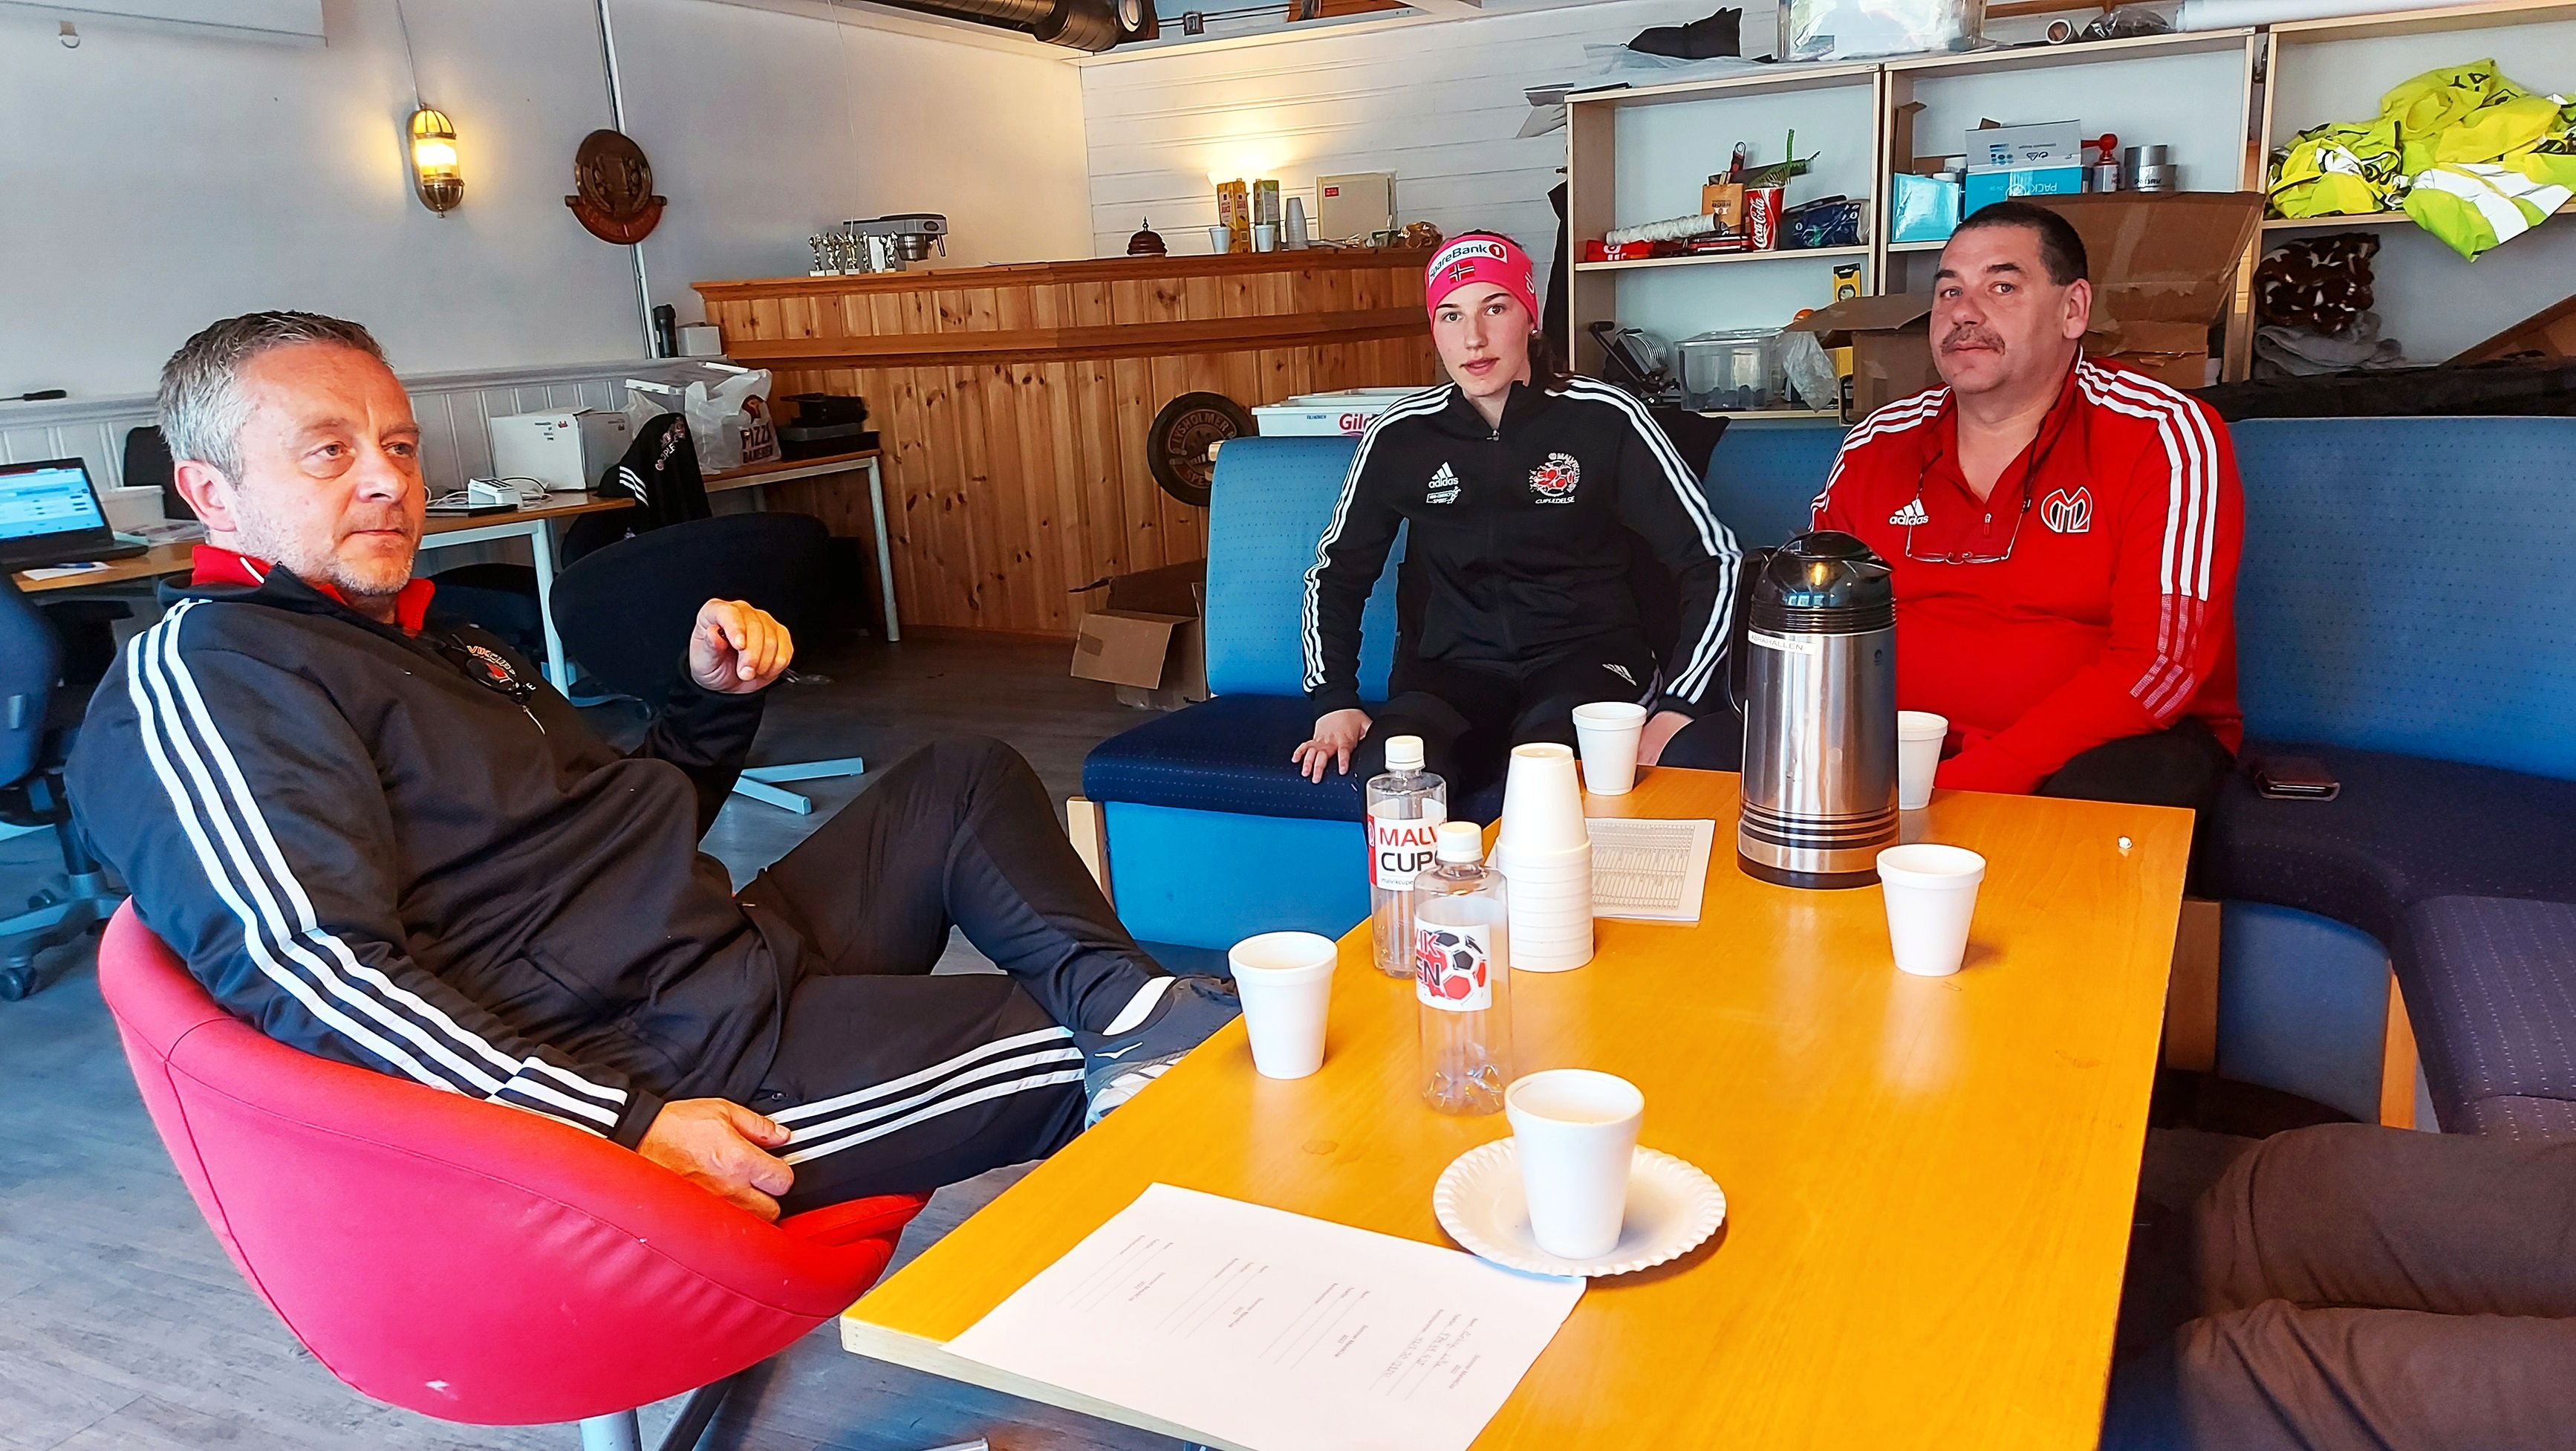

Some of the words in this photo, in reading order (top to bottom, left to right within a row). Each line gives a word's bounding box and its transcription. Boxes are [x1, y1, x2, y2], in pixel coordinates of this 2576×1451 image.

[1428, 477, 1460, 489] adidas
[1889, 514, 1929, 525] adidas
[1381, 851, 1438, 872] CUP
[1416, 955, 1440, 987] EN
